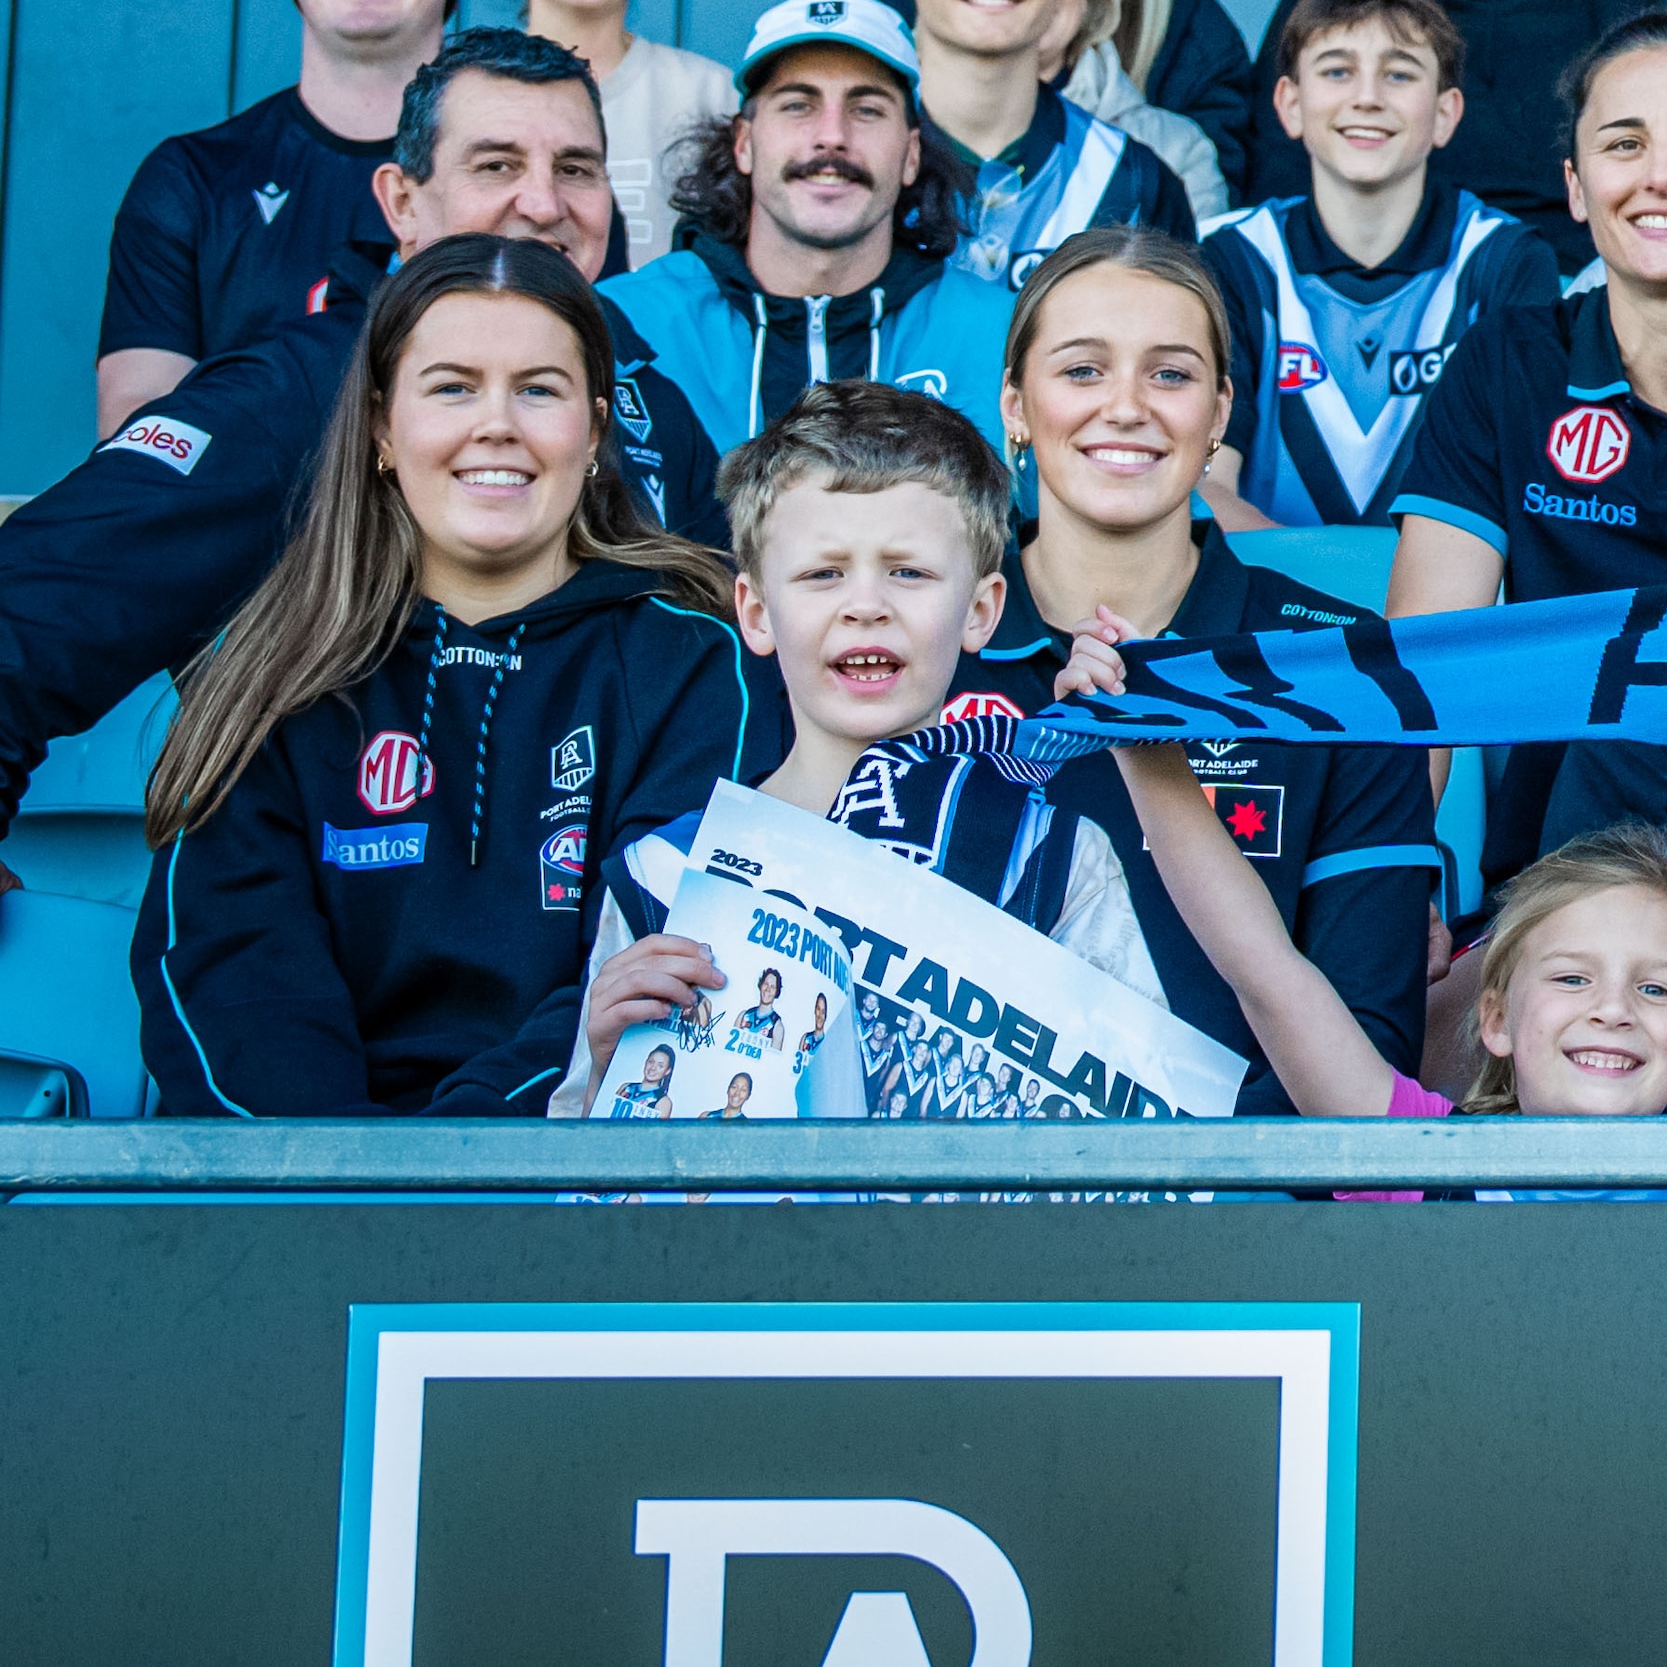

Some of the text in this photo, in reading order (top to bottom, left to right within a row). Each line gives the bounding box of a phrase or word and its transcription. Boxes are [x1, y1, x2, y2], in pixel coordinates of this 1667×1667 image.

[1278, 353, 1322, 381] FL
[1556, 412, 1624, 475] MG
[1523, 483, 1637, 527] Santos
[1281, 603, 1357, 626] COTTON:ON
[1206, 758, 1259, 770] ADELAIDE
[327, 829, 420, 865] Santos
[710, 848, 763, 877] 2023
[747, 908, 800, 959] 2023
[799, 931, 834, 980] PORT
[724, 1028, 741, 1052] 2
[896, 956, 1200, 1118] ADELAID
